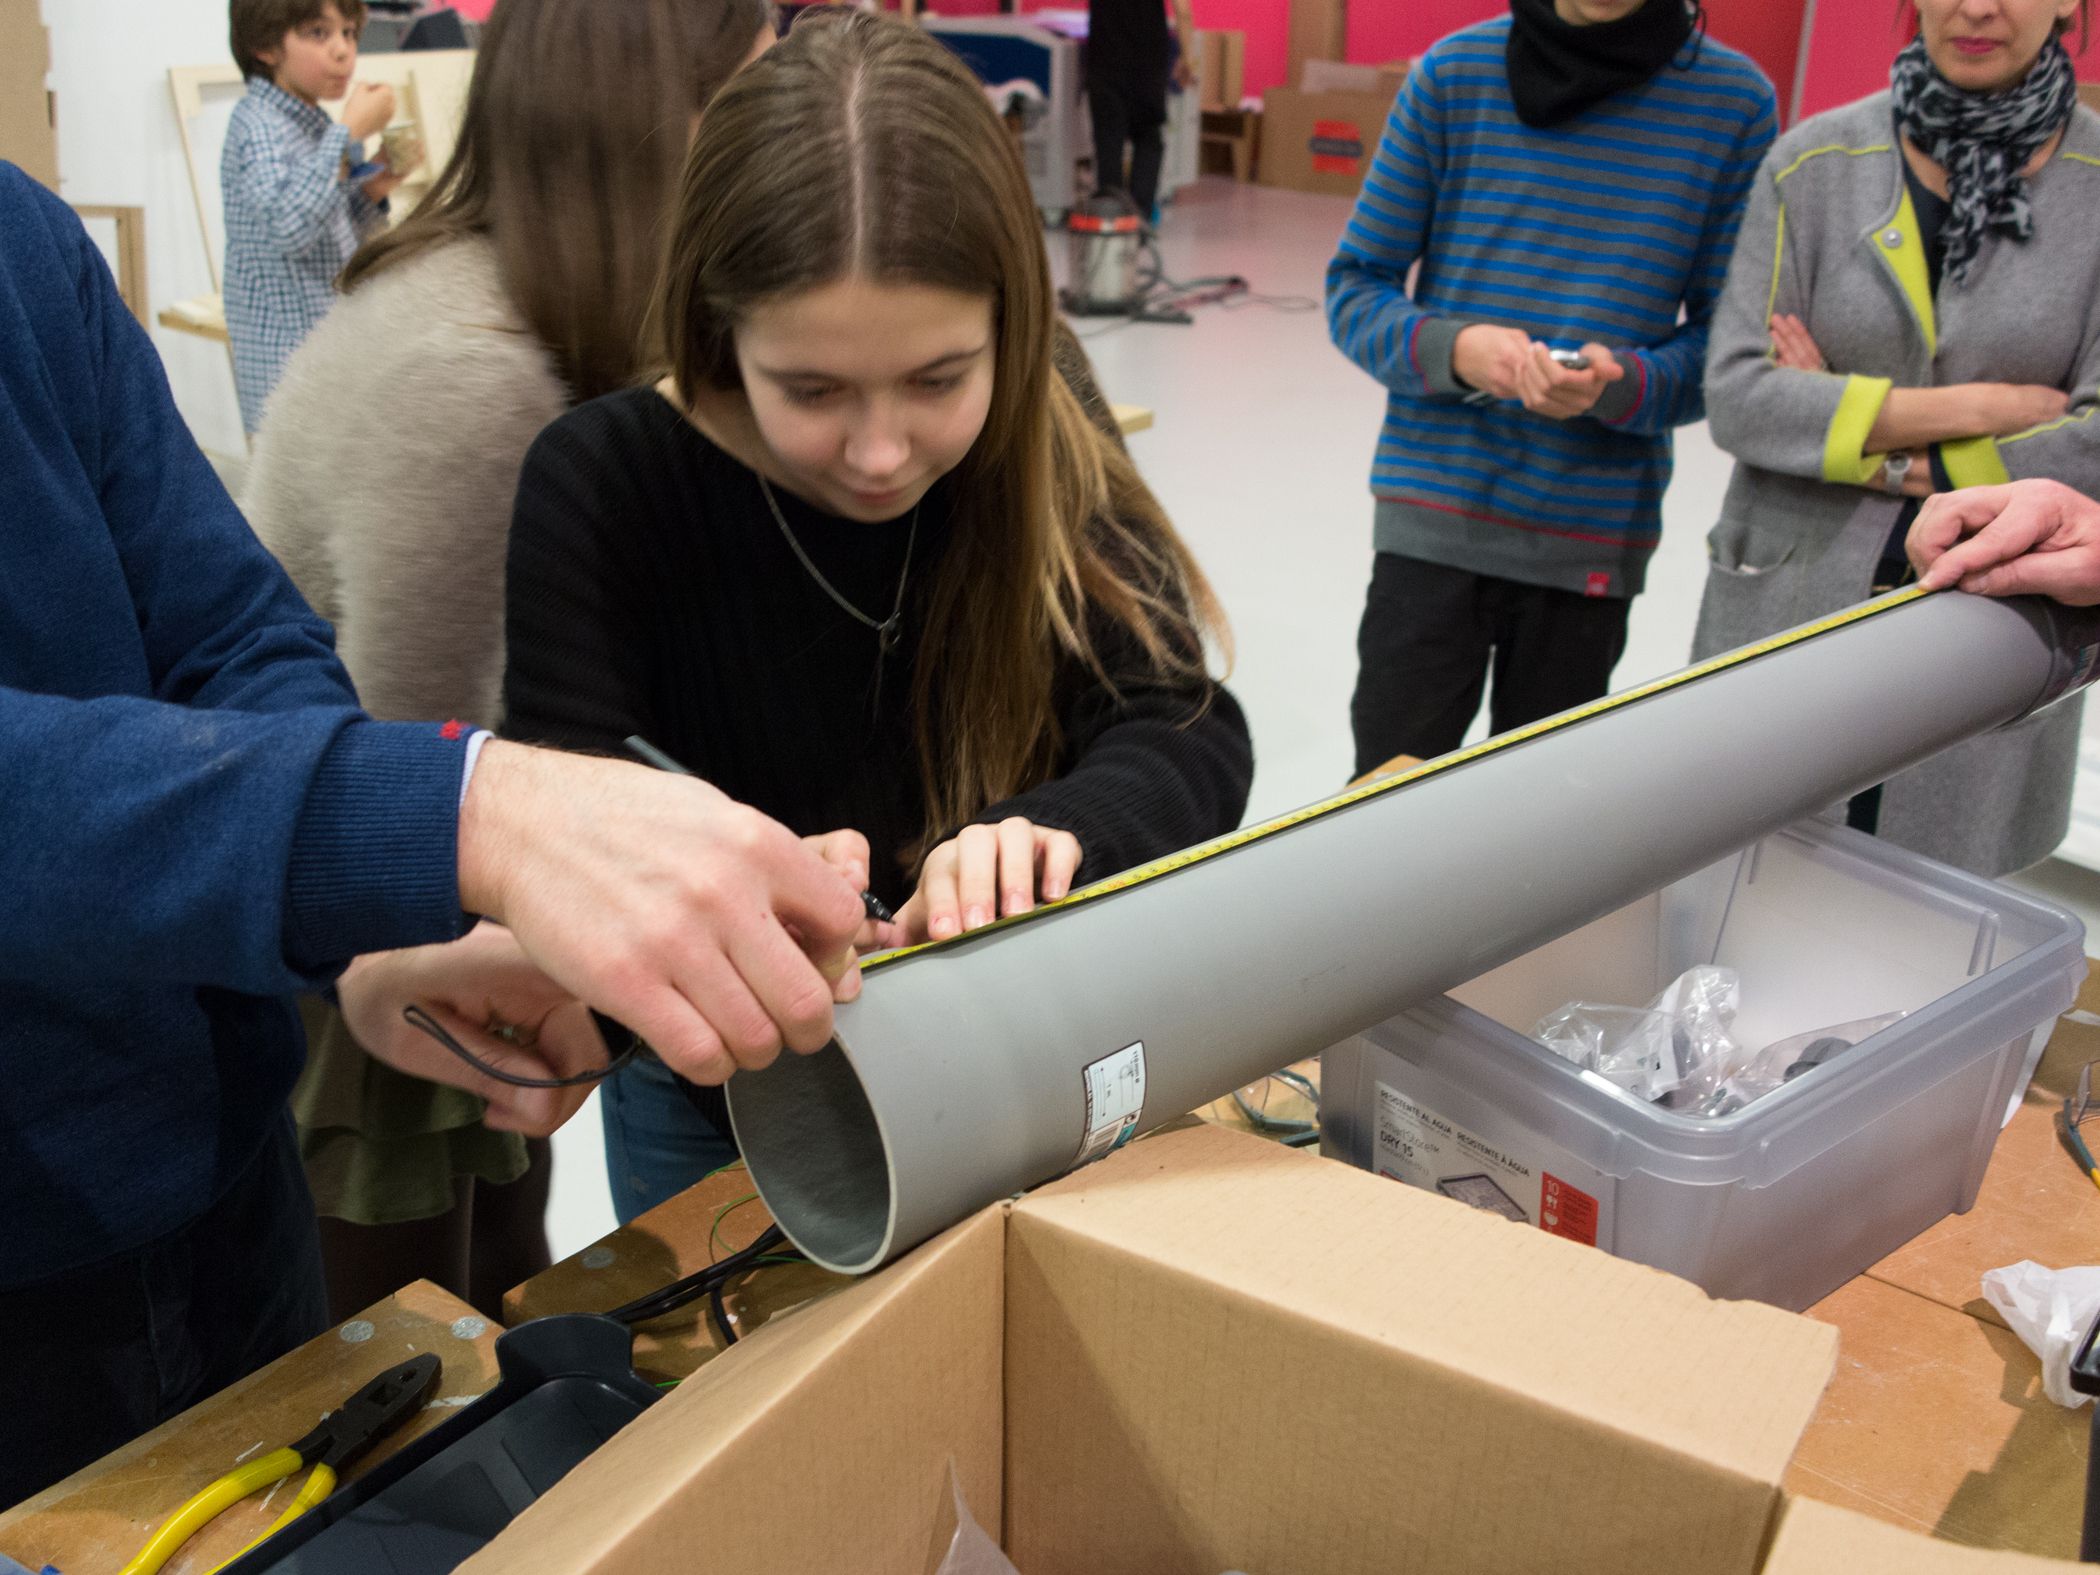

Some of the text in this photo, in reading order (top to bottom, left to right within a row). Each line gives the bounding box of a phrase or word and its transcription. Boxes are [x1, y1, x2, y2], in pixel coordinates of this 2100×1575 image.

[1380, 1089, 1420, 1117] RESISTENTE
[1380, 1130, 1414, 1158] DRY 15
[1457, 1132, 1500, 1160] RESISTENTE
[1546, 1180, 1560, 1196] 10
